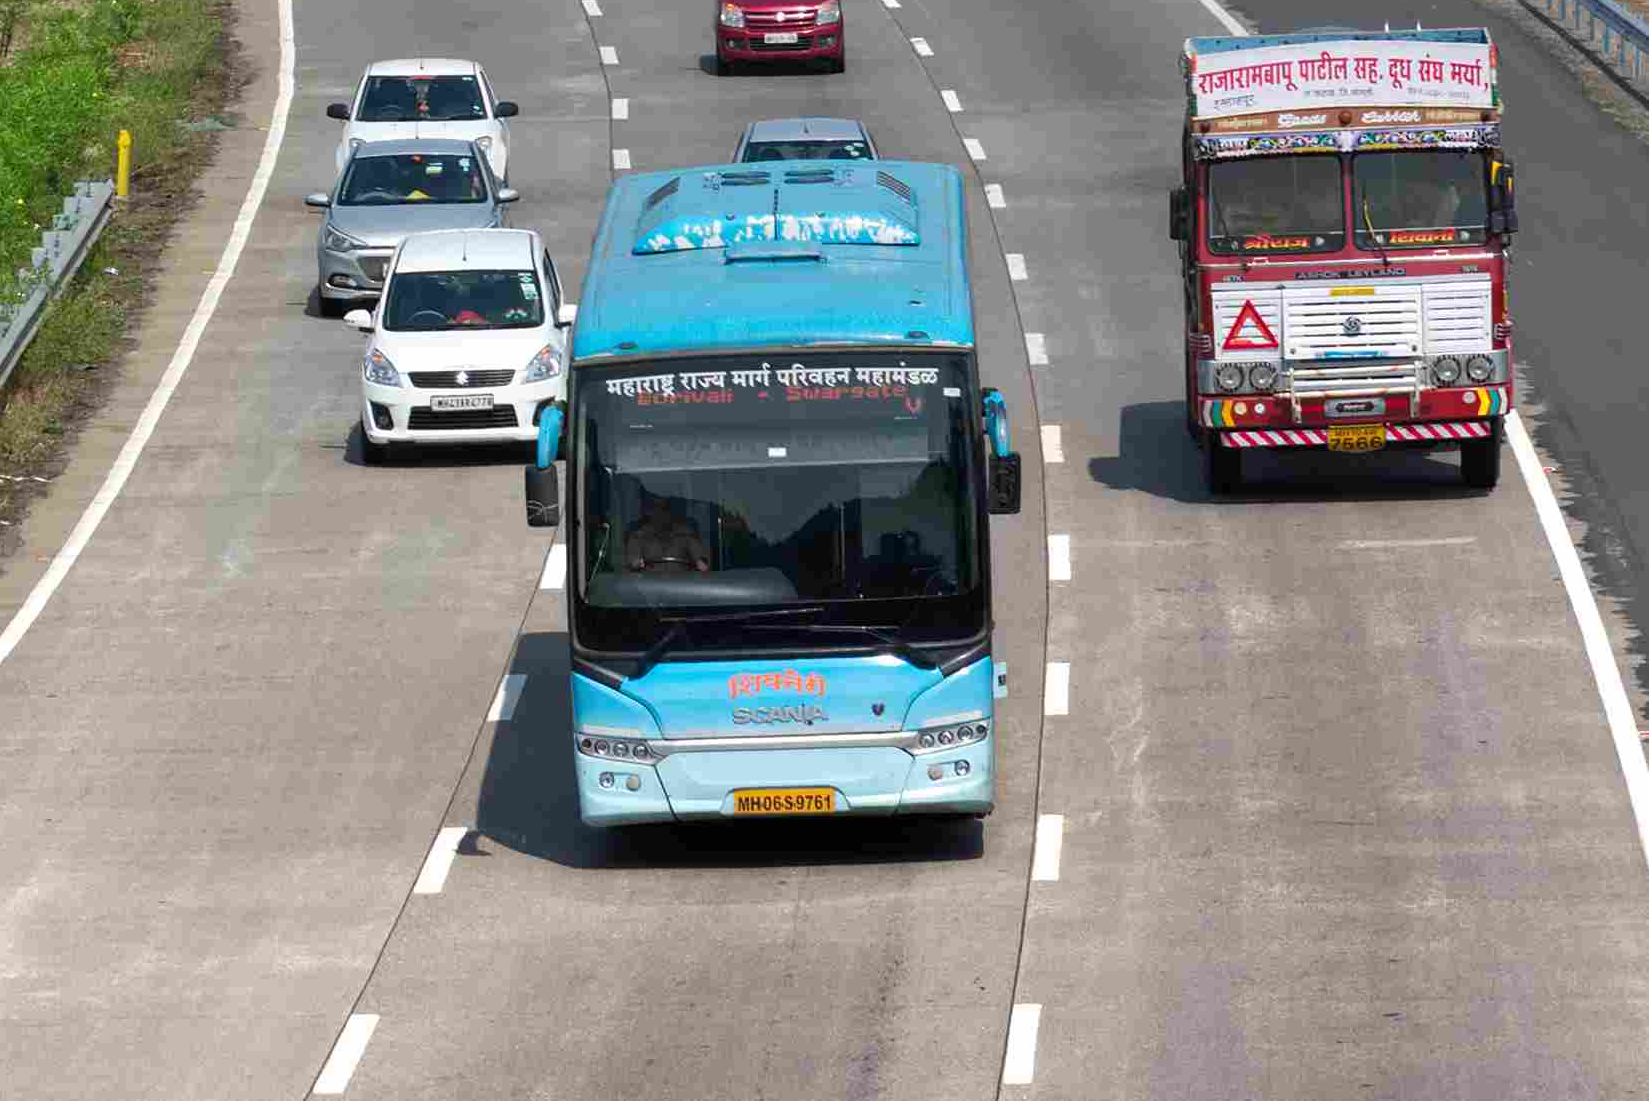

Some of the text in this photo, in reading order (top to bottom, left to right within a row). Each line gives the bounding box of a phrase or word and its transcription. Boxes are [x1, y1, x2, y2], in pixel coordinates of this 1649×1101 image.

[1199, 61, 1298, 93] राजारामबापू
[1298, 51, 1348, 81] पाटील
[1354, 58, 1383, 83] सह.
[1388, 58, 1412, 89] दूध
[1419, 53, 1444, 83] संघ
[1347, 267, 1407, 278] LEYLAND
[606, 361, 939, 396] महाराष्ट्र राज्य मार्ग परिवहन महामंडळ
[732, 705, 829, 725] SCANIA
